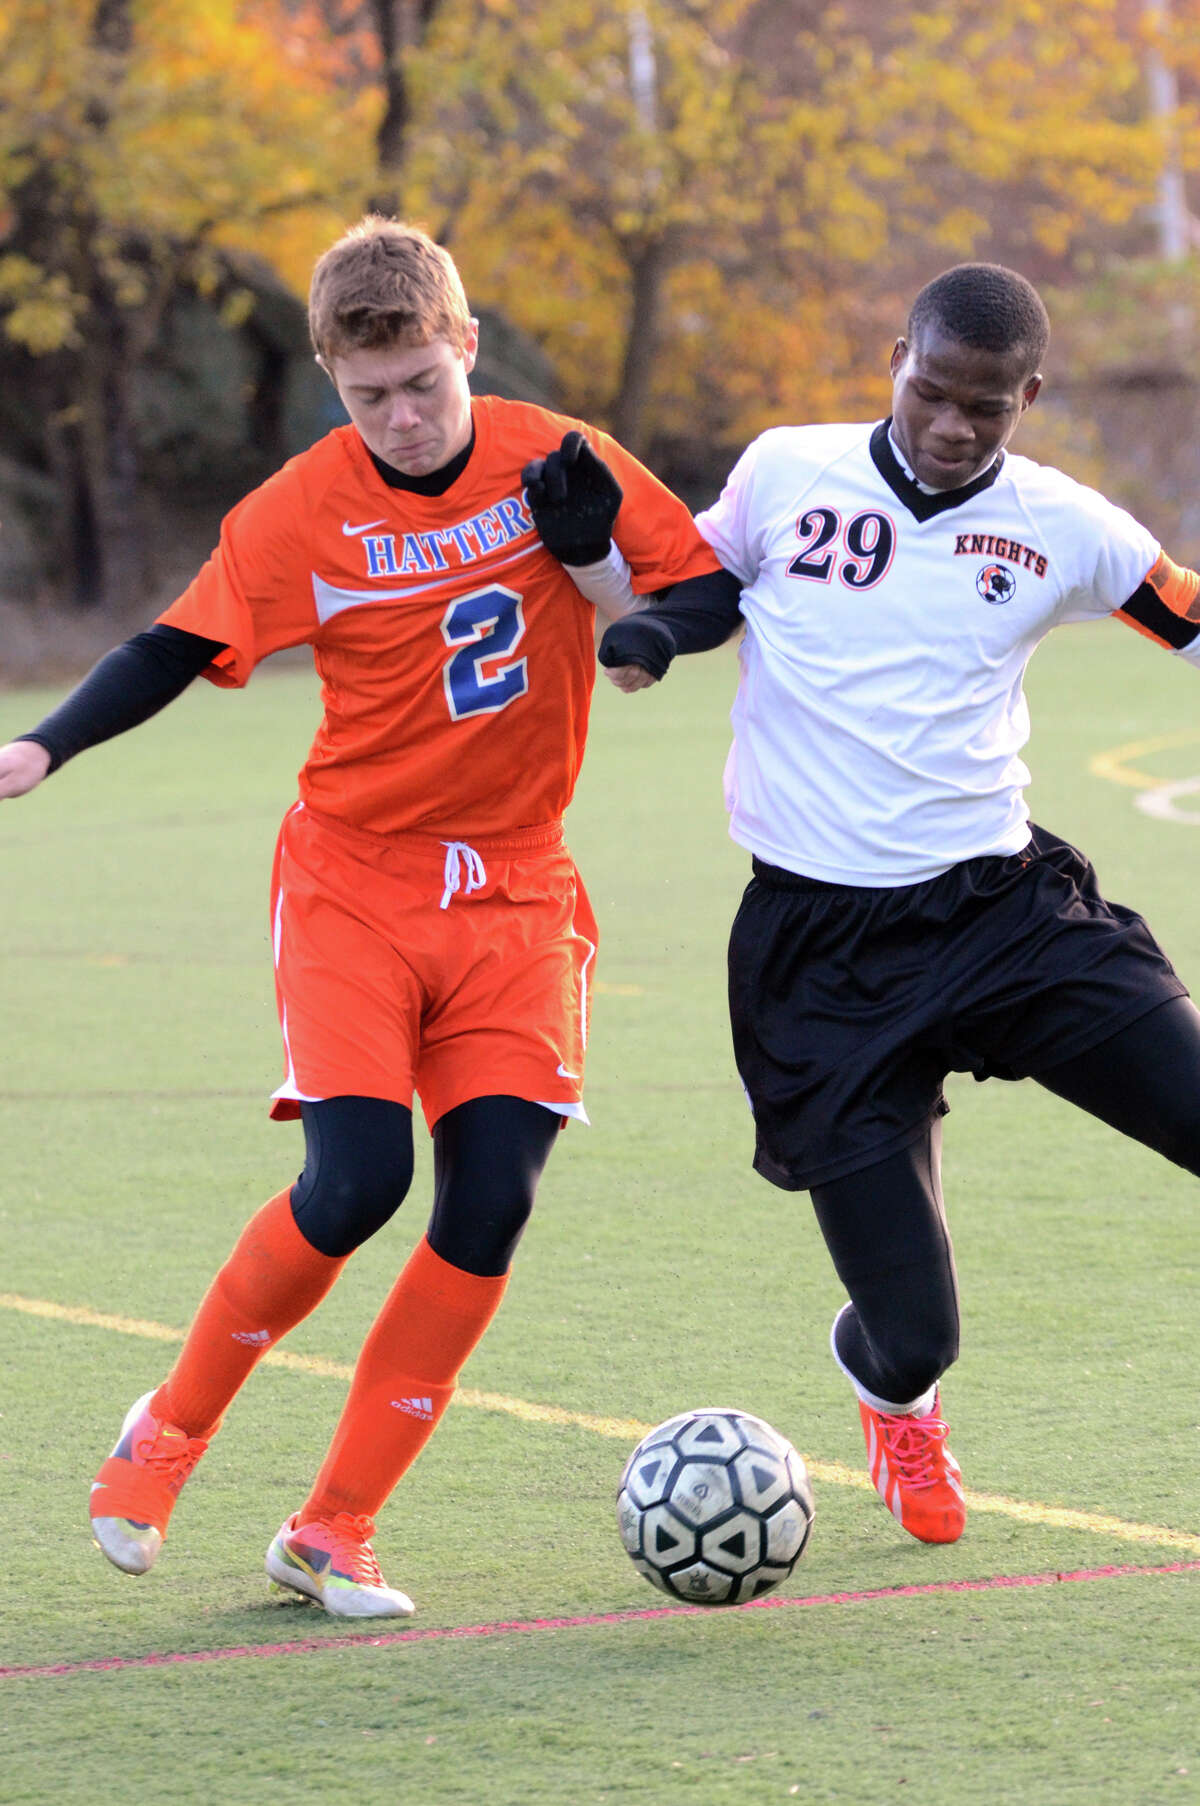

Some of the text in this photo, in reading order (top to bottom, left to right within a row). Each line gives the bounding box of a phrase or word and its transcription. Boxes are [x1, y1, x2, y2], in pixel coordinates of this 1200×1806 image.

[362, 486, 535, 577] HATTER
[785, 505, 897, 591] 29
[954, 534, 1048, 579] KNIGHTS
[440, 583, 529, 721] 2
[390, 1400, 433, 1420] adidas
